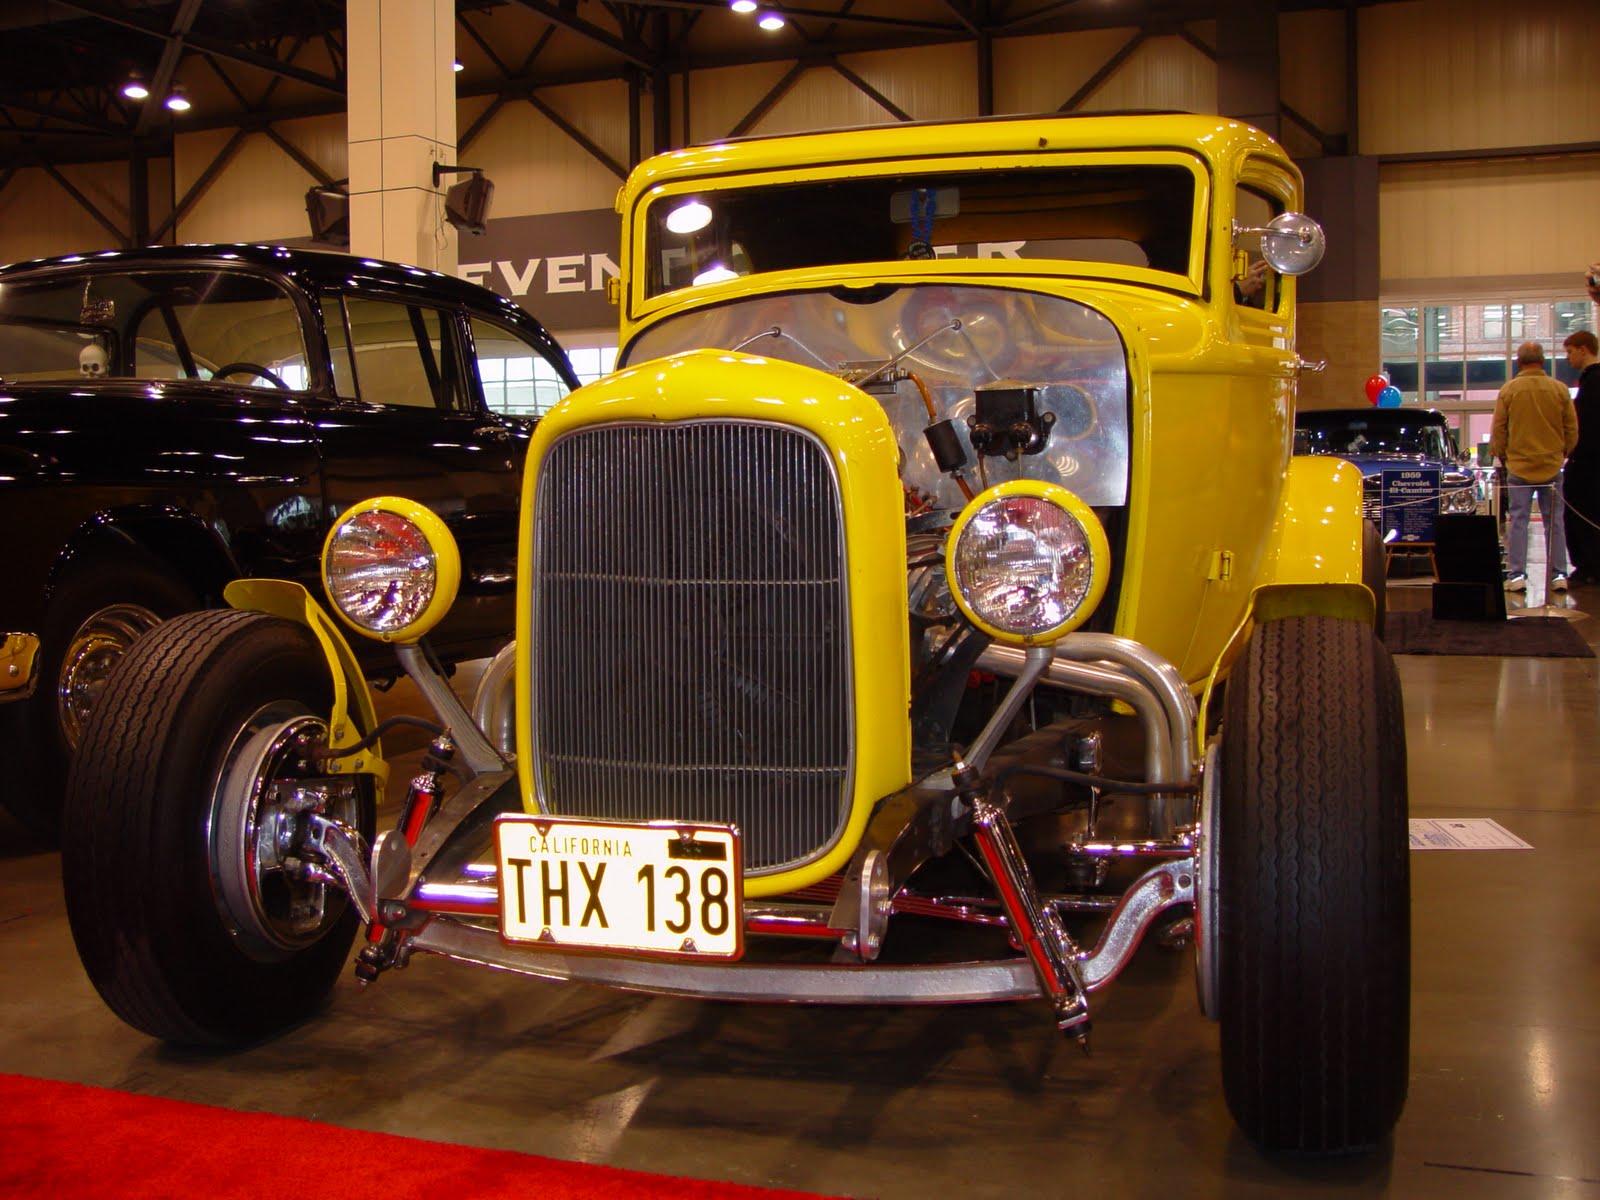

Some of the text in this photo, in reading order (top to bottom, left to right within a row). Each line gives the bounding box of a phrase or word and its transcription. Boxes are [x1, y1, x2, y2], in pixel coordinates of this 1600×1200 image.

[529, 835, 633, 858] CALIFORNIA
[507, 857, 730, 936] THX 138
